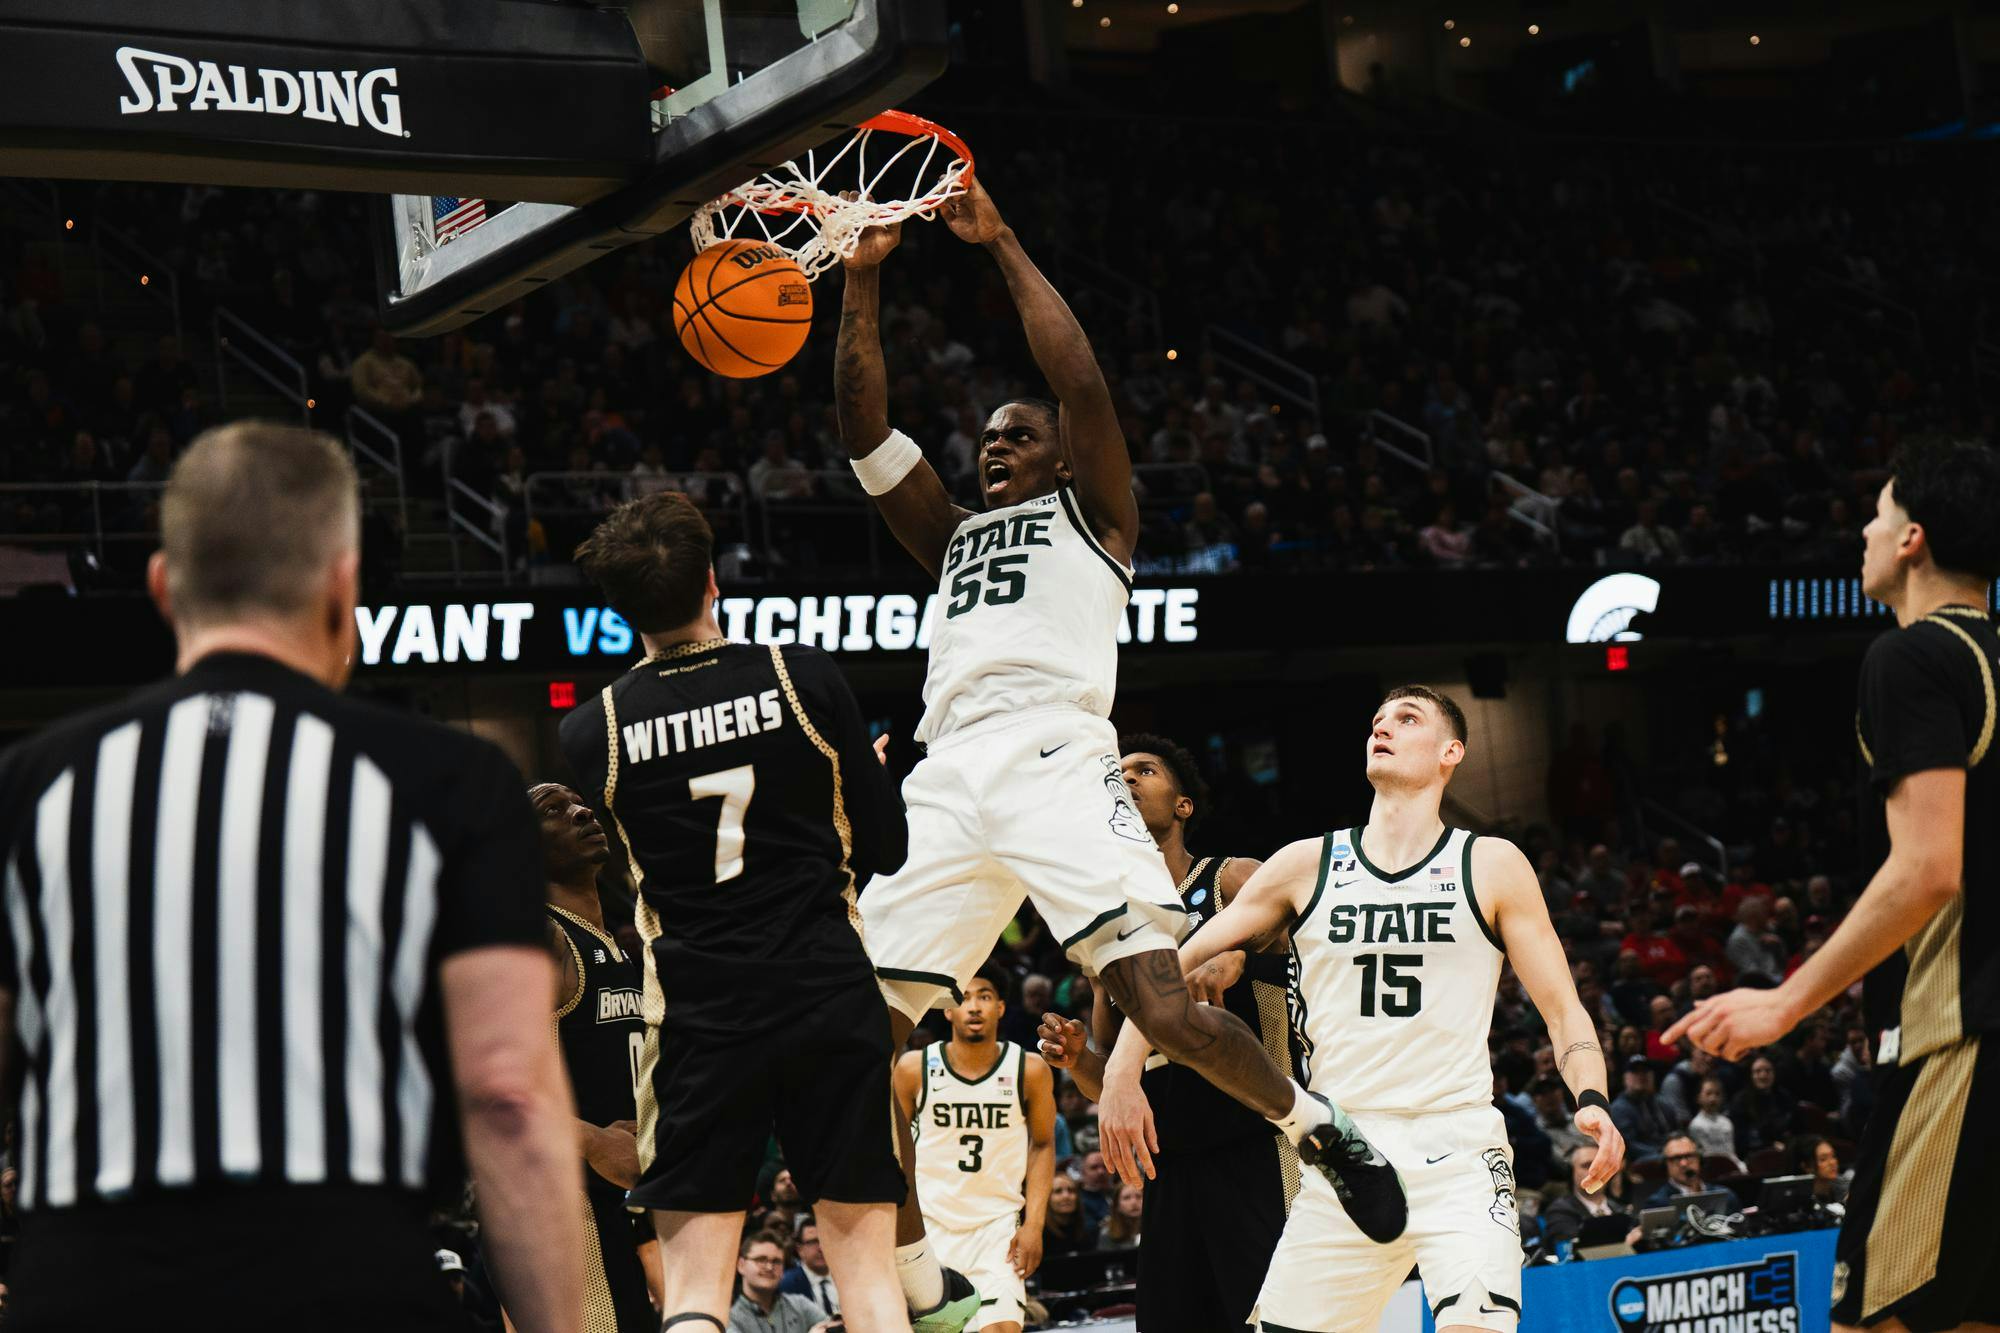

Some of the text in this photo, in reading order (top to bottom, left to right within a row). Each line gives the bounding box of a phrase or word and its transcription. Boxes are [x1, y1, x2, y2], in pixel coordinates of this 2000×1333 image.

[116, 46, 404, 137] SPALDING
[946, 511, 1056, 575] STATE
[946, 553, 1029, 620] 55
[354, 603, 534, 665] YANT
[563, 607, 634, 656] VS
[623, 688, 783, 764] WITHERS
[688, 764, 755, 884] 7
[1328, 902, 1457, 943] STATE
[600, 991, 645, 1019] BRYAN
[1353, 953, 1424, 1018] 15
[932, 1103, 1012, 1129] STATE
[958, 1135, 984, 1173] 3
[1646, 1272, 1746, 1324] MARCH
[1664, 1306, 1798, 1333] NESS
